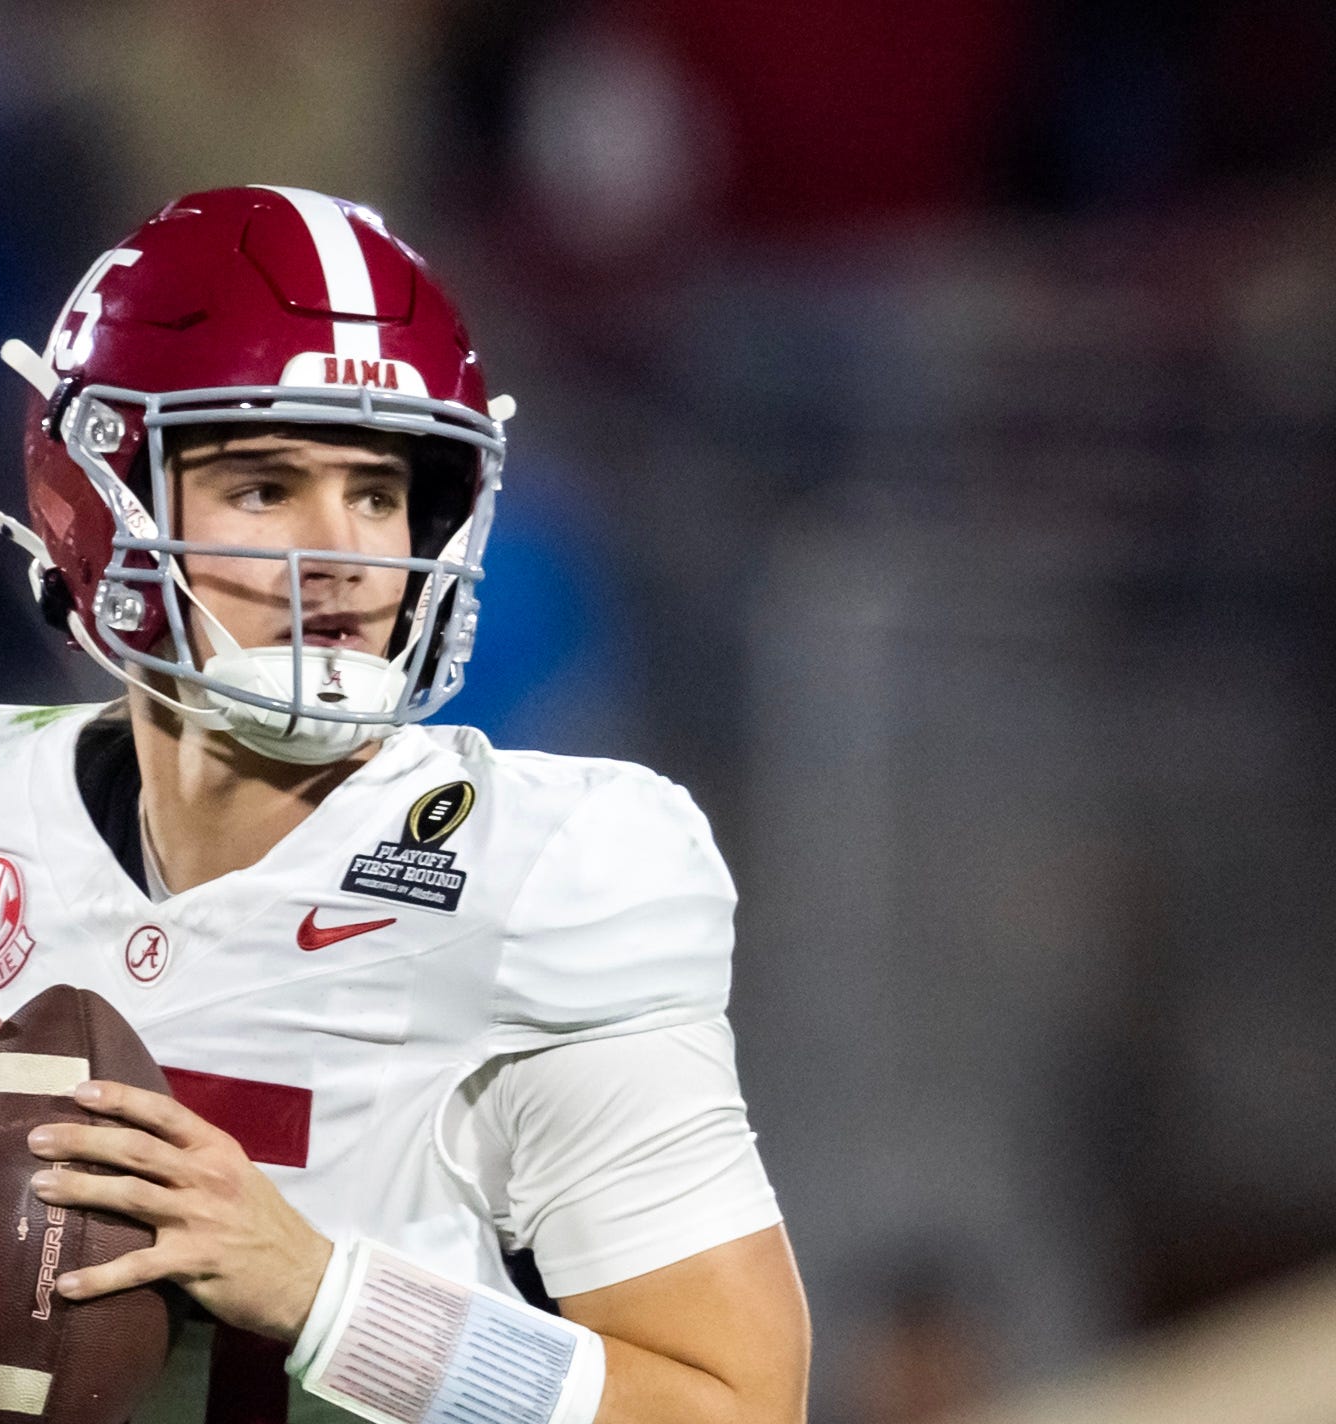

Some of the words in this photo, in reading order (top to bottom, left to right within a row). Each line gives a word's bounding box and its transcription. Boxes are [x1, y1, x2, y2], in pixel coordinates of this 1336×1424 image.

[324, 357, 399, 390] BAMA
[351, 857, 404, 879] FIRST
[402, 866, 463, 890] ROUND
[375, 845, 452, 869] PLAYOFF
